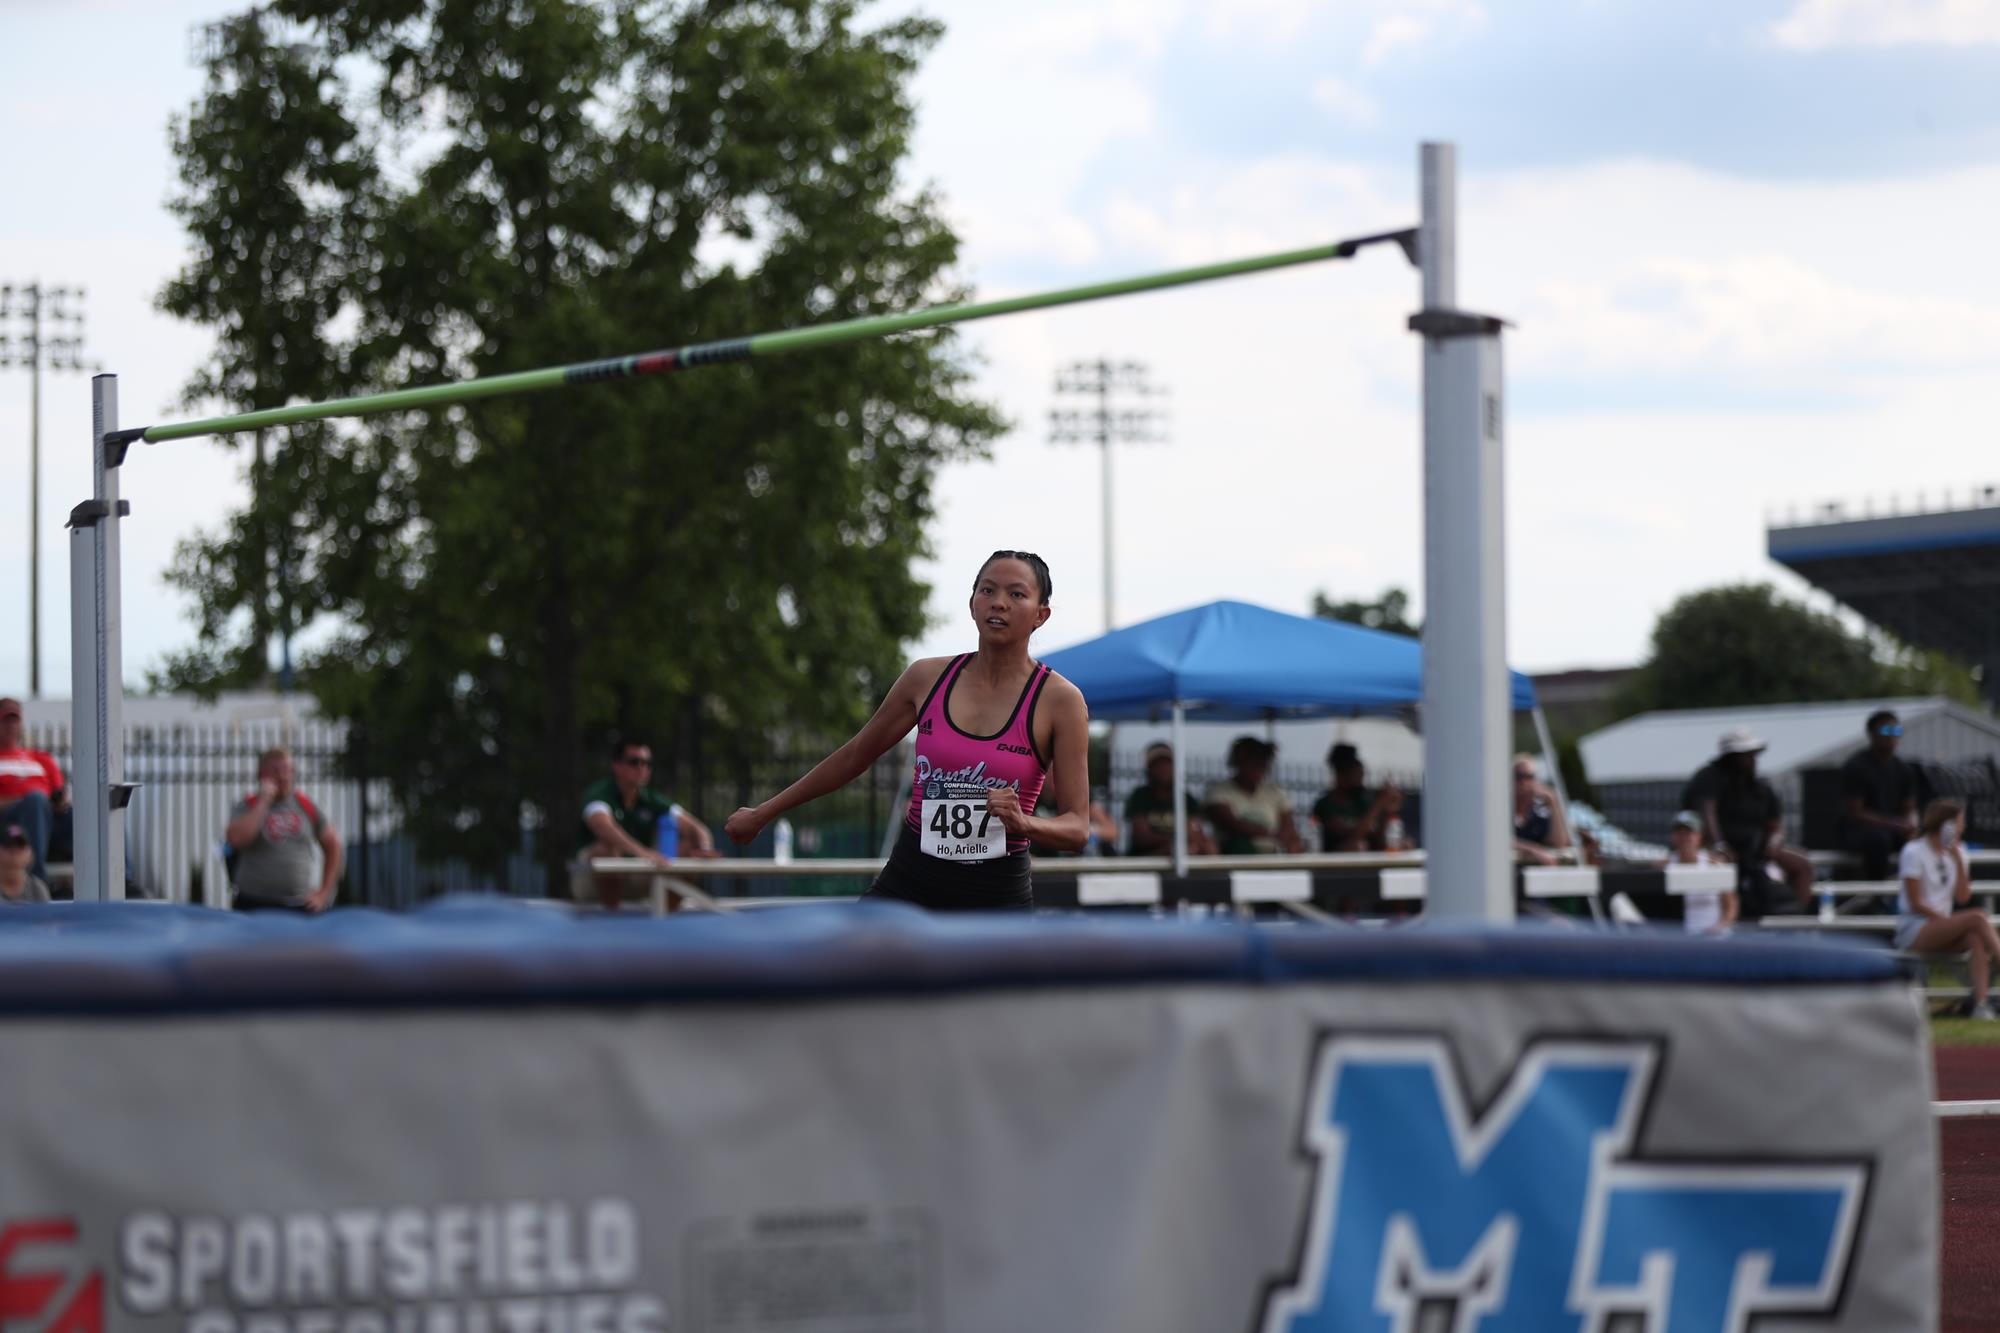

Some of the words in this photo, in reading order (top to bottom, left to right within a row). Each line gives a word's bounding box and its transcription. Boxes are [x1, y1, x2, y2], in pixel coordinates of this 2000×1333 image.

[930, 804, 991, 839] 487
[937, 844, 953, 856] Ho,
[955, 844, 988, 855] Arielle
[1260, 1032, 1872, 1333] MT
[121, 1199, 638, 1310] SPORTSFIELD
